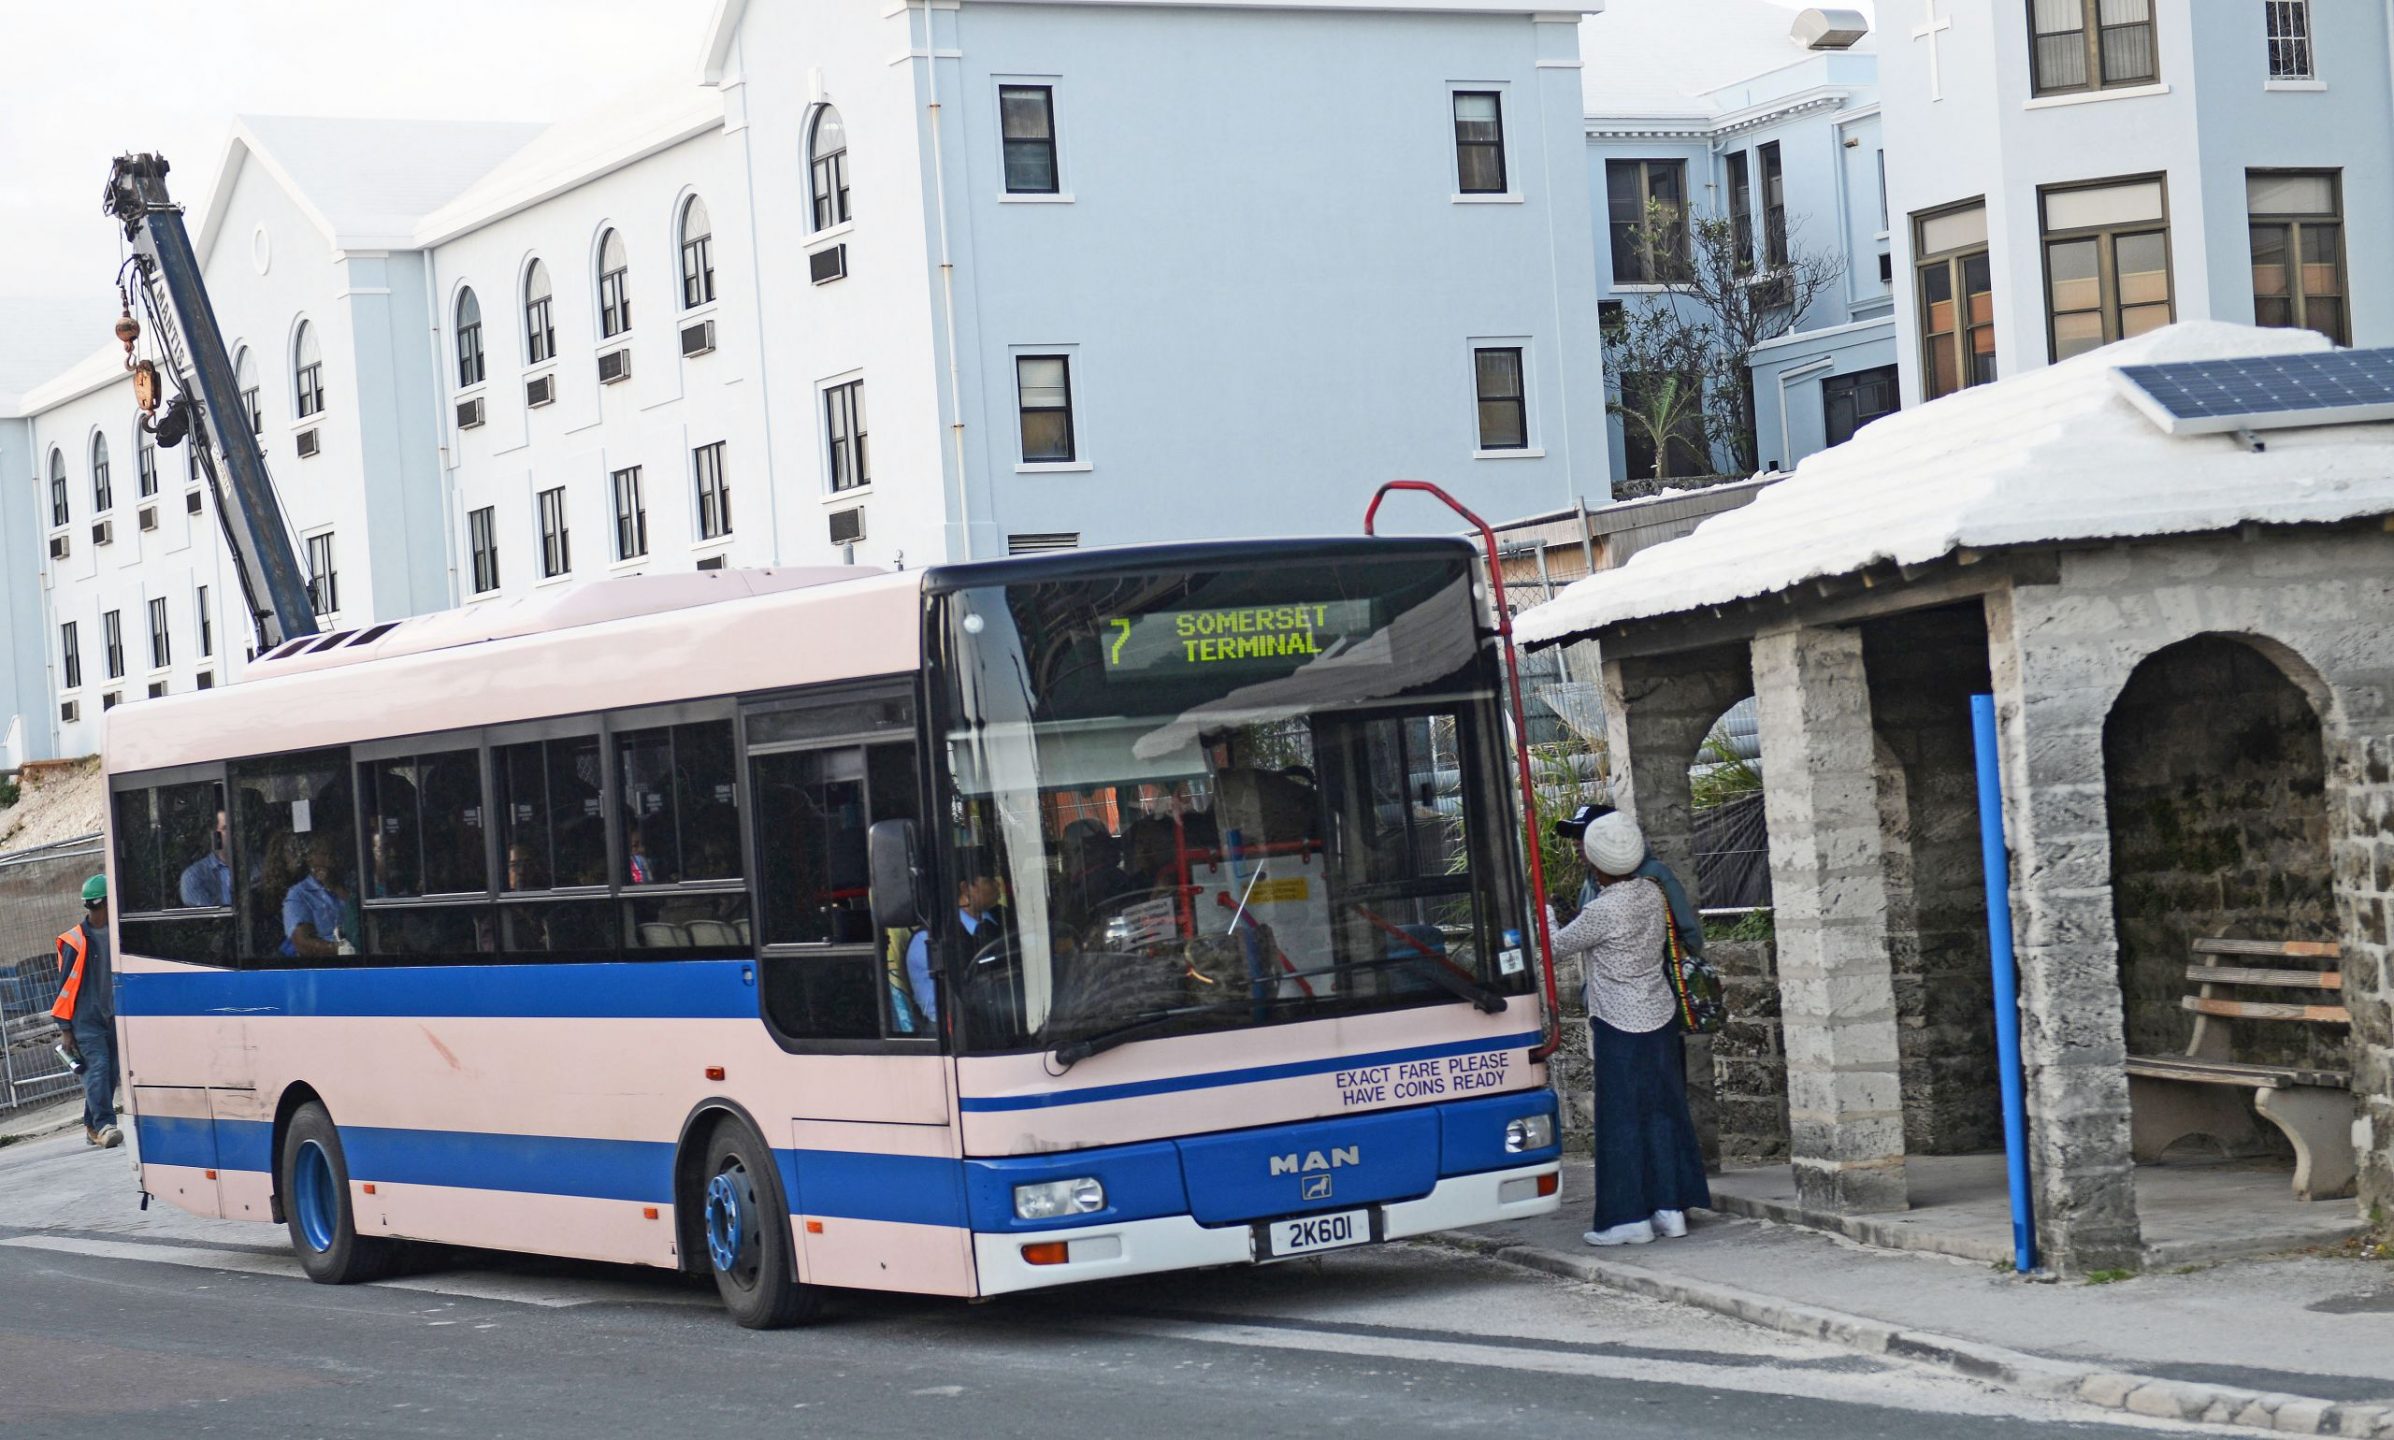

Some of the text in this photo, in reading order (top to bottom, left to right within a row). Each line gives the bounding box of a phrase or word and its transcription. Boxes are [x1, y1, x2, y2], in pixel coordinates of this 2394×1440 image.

[157, 284, 184, 367] MANTIS
[1176, 605, 1328, 637] SOMERSET
[1110, 618, 1131, 665] 7
[1183, 632, 1322, 663] TERMINAL
[1336, 1052, 1509, 1088] EXACT FARE PLEASE
[1343, 1070, 1505, 1106] HAVE COINS READY
[1270, 1145, 1360, 1176] MAN
[1289, 1215, 1352, 1248] 2K601
